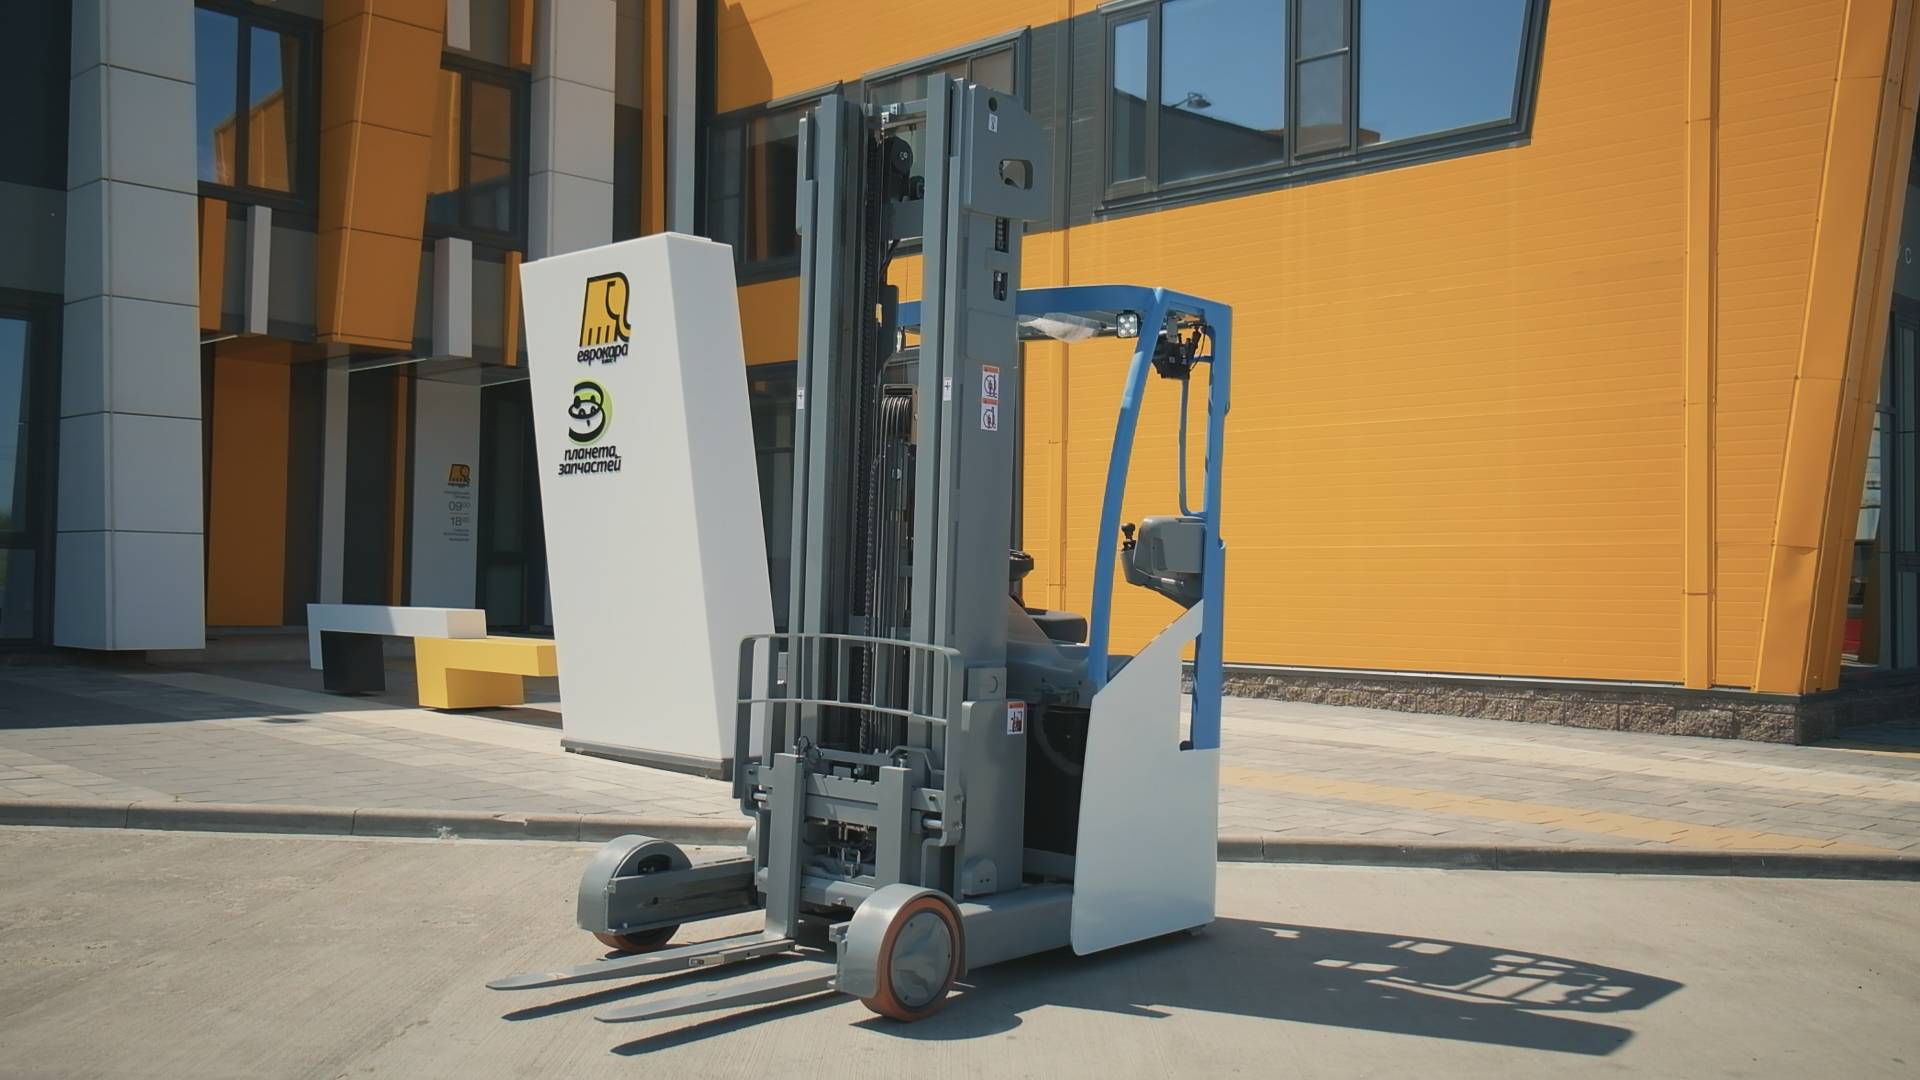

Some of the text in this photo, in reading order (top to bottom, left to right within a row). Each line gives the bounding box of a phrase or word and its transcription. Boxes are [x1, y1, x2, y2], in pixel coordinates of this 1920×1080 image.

[577, 343, 628, 366] еврокара
[564, 445, 617, 461] планета
[558, 455, 622, 475] запчастей
